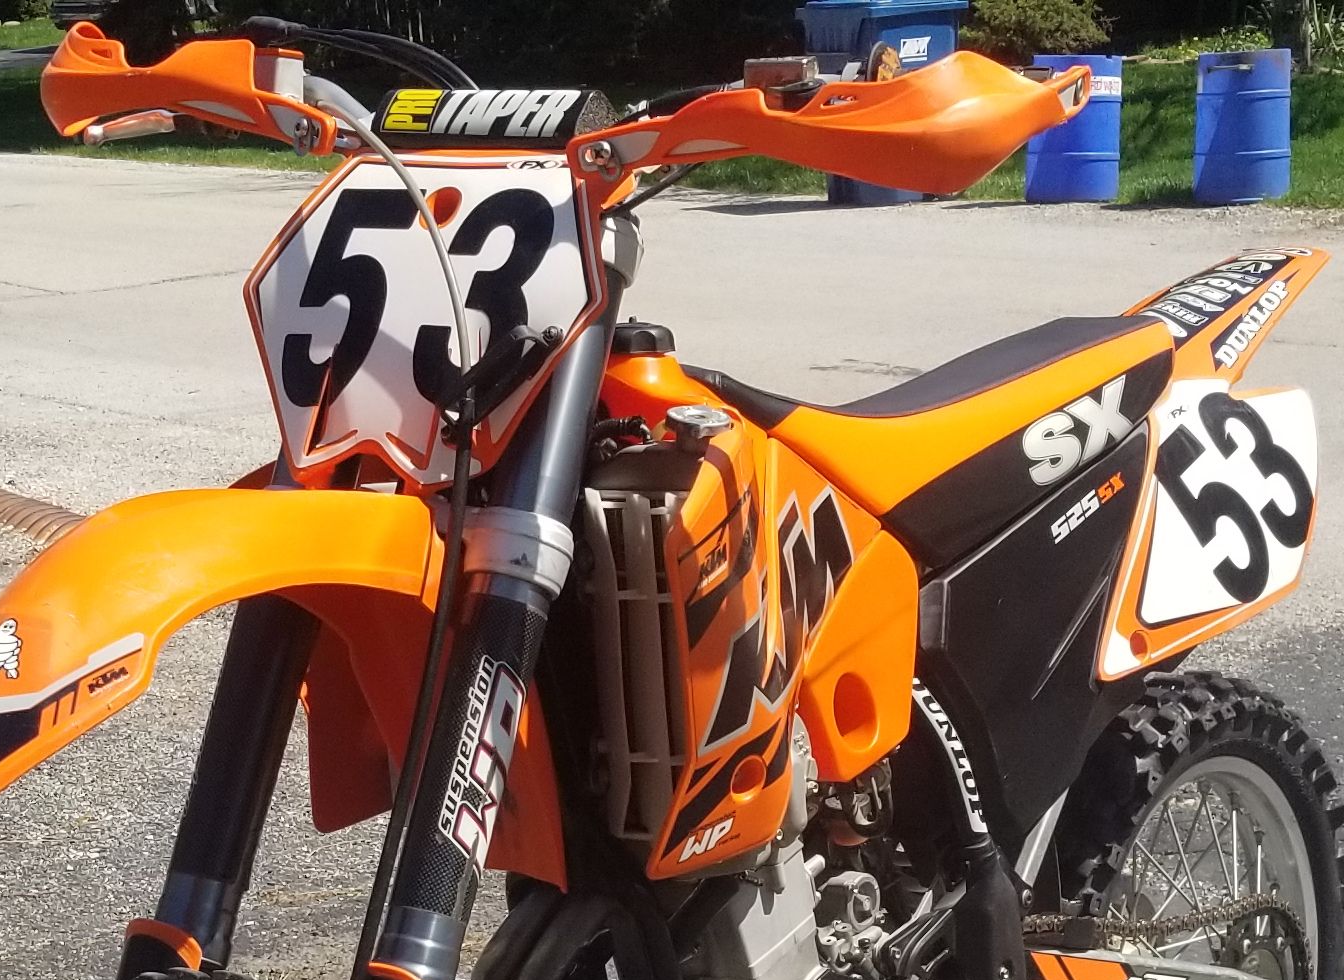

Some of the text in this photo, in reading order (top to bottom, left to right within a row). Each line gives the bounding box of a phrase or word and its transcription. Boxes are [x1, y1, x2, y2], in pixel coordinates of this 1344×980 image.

[383, 89, 582, 137] PRO TAPER
[281, 187, 555, 411] 53
[1215, 280, 1289, 369] DUNLOP
[1022, 374, 1133, 486] SX
[1154, 391, 1315, 604] 53
[88, 666, 129, 693] KTM
[439, 655, 497, 836] suspension
[678, 817, 734, 863] WP
